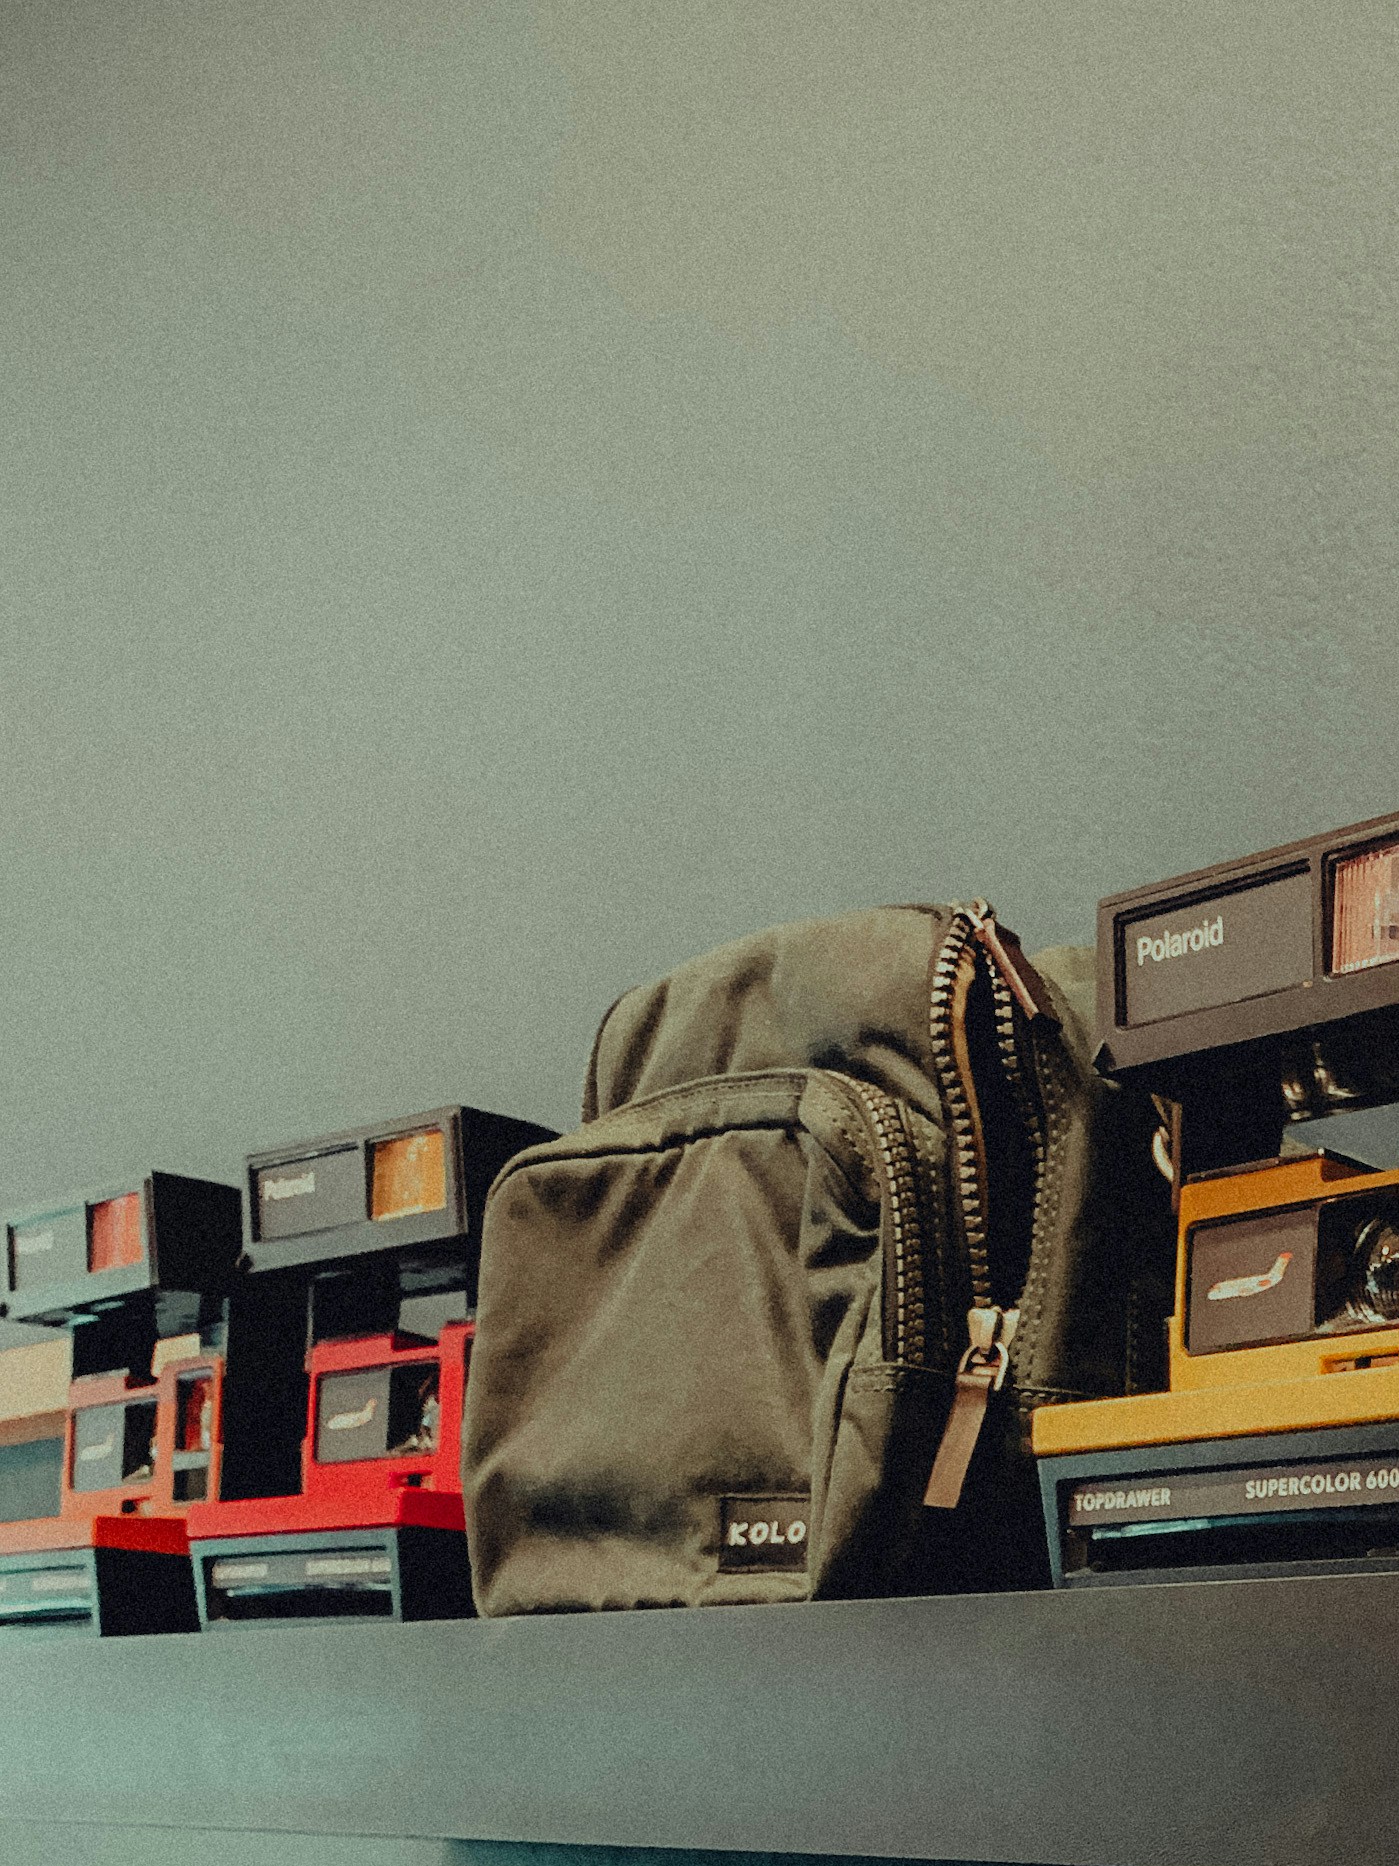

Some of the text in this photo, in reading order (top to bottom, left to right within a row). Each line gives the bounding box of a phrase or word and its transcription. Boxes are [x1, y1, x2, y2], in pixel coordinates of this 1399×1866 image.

[1136, 915, 1224, 966] Polaroid
[1074, 1468, 1399, 1511] TOPDRAWER SUPERCOLOR 600
[728, 1520, 807, 1546] KOLO
